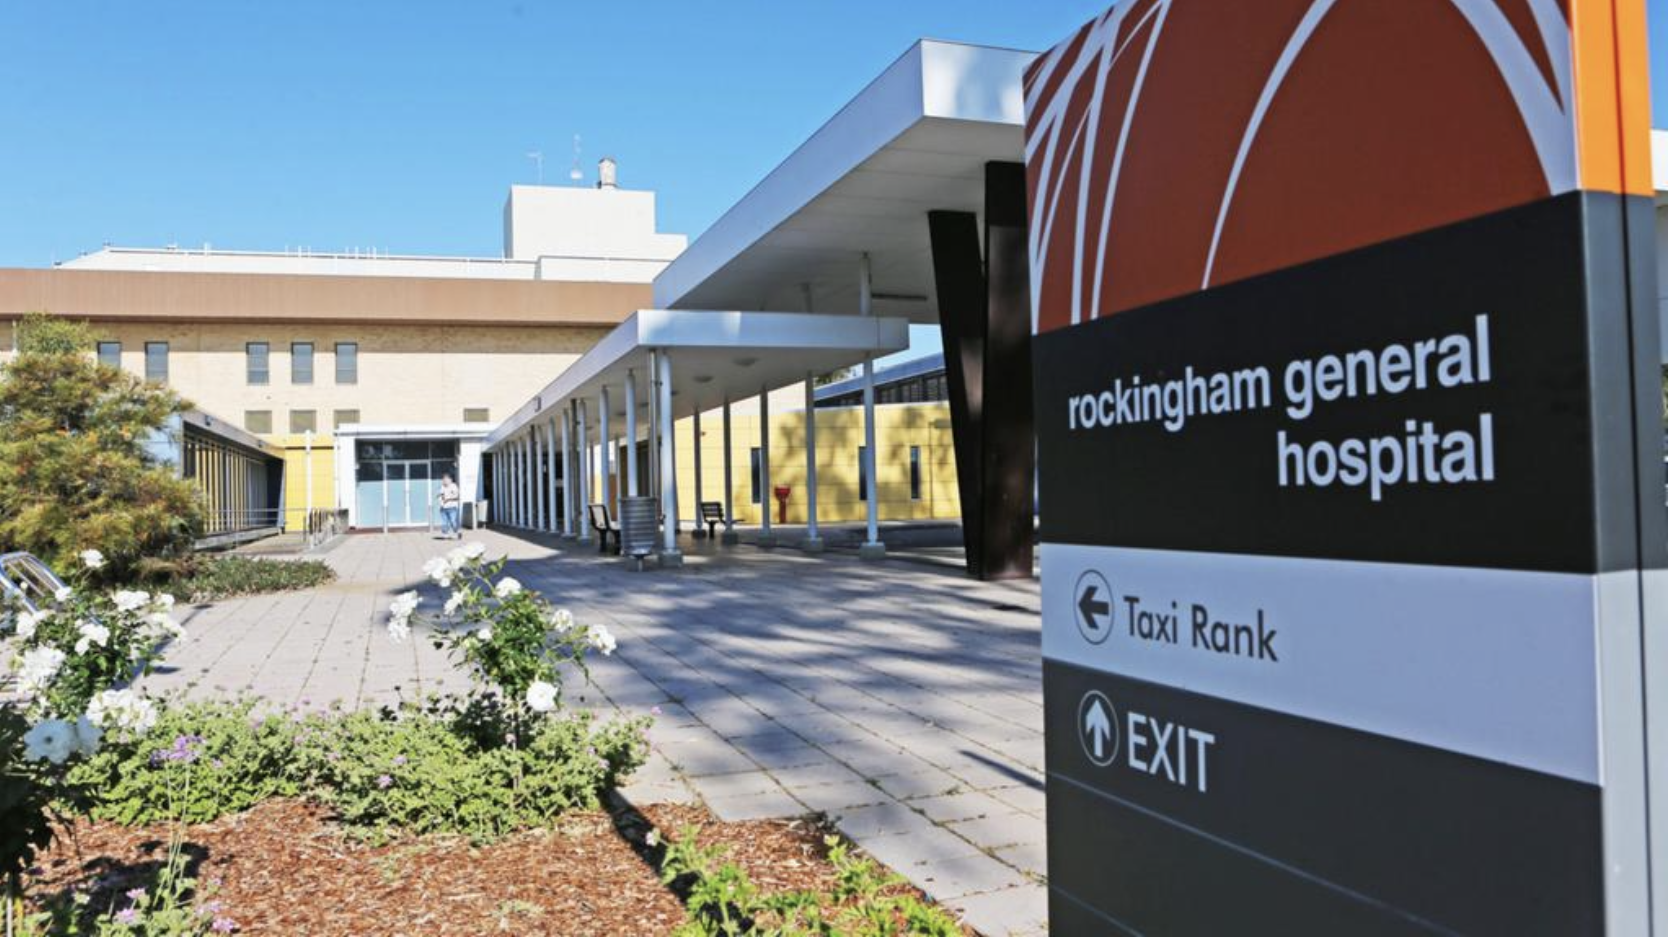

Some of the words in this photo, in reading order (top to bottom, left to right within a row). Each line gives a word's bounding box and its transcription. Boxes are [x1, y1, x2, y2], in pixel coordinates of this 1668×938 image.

[1068, 366, 1271, 432] rockingham
[1285, 314, 1492, 420] general
[1278, 413, 1495, 502] hospital
[1122, 594, 1180, 646] Taxi
[1190, 603, 1279, 664] Rank
[1127, 712, 1216, 793] EXIT
